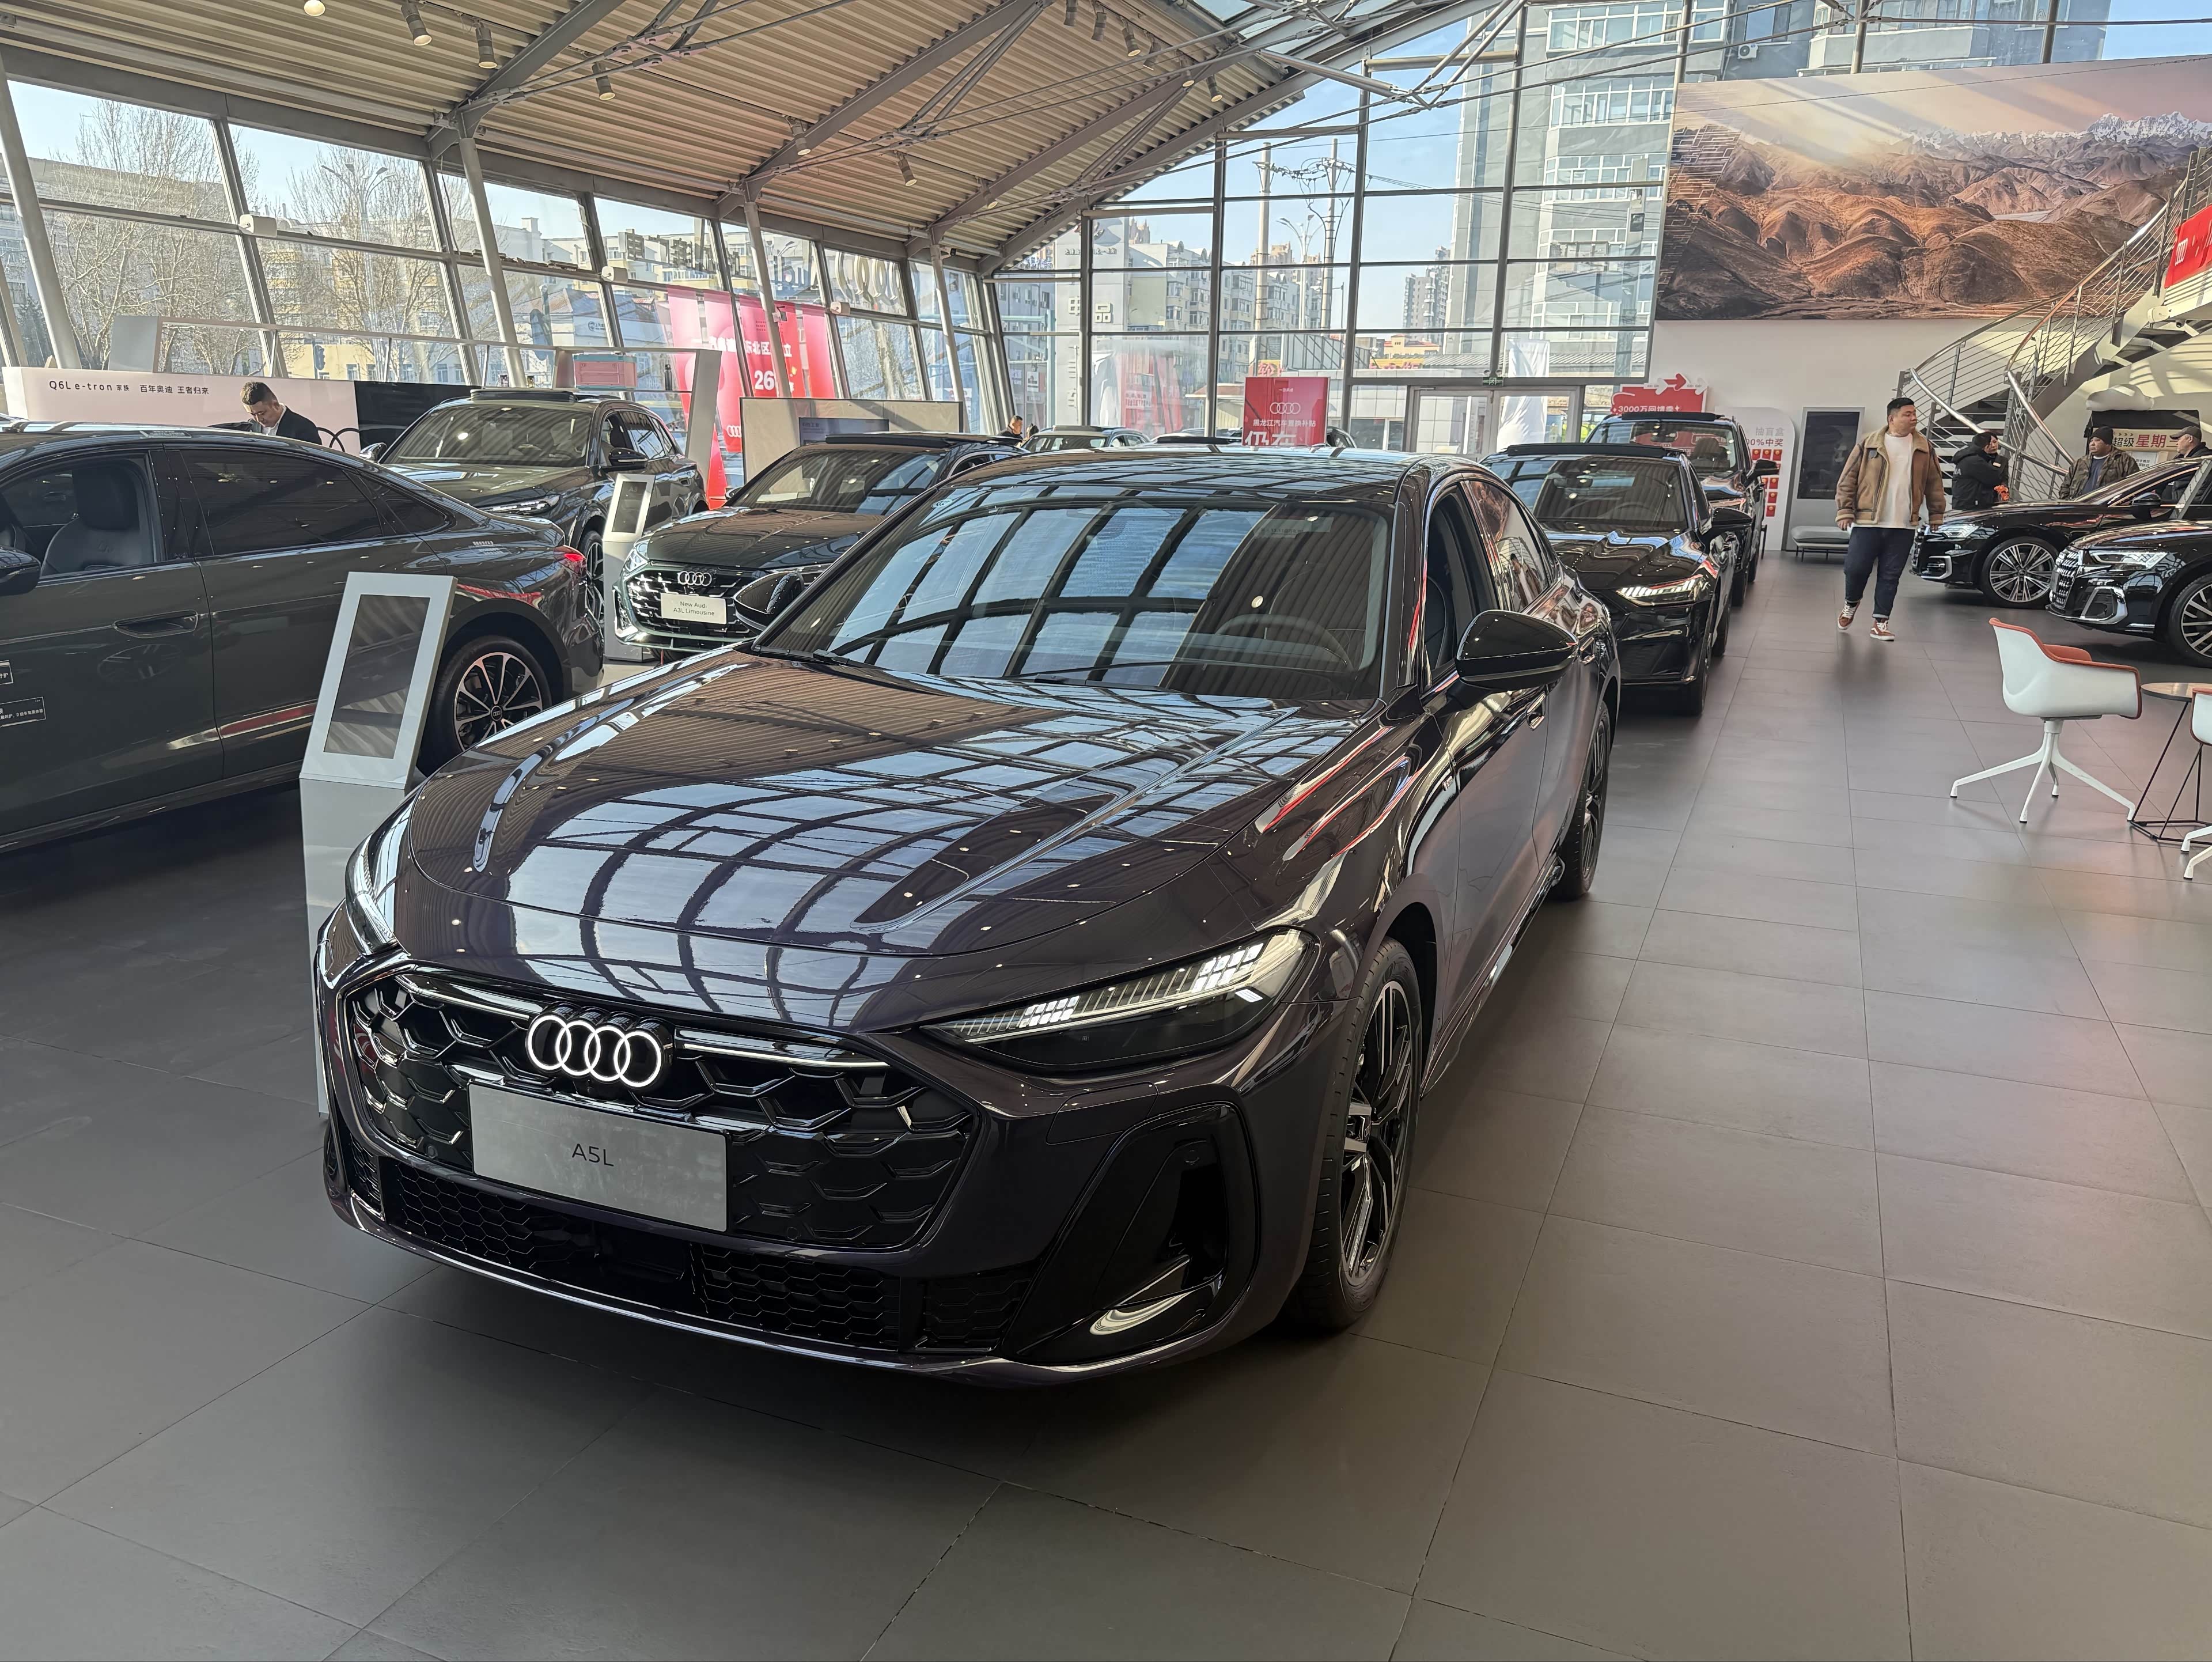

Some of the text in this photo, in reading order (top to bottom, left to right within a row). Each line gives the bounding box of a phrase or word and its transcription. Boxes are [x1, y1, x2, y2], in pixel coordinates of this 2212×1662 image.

[49, 380, 112, 391] Q6L e-tron
[139, 384, 173, 393] 百年奥迪
[177, 386, 209, 395] 王者归来
[572, 1143, 614, 1167] A5L
